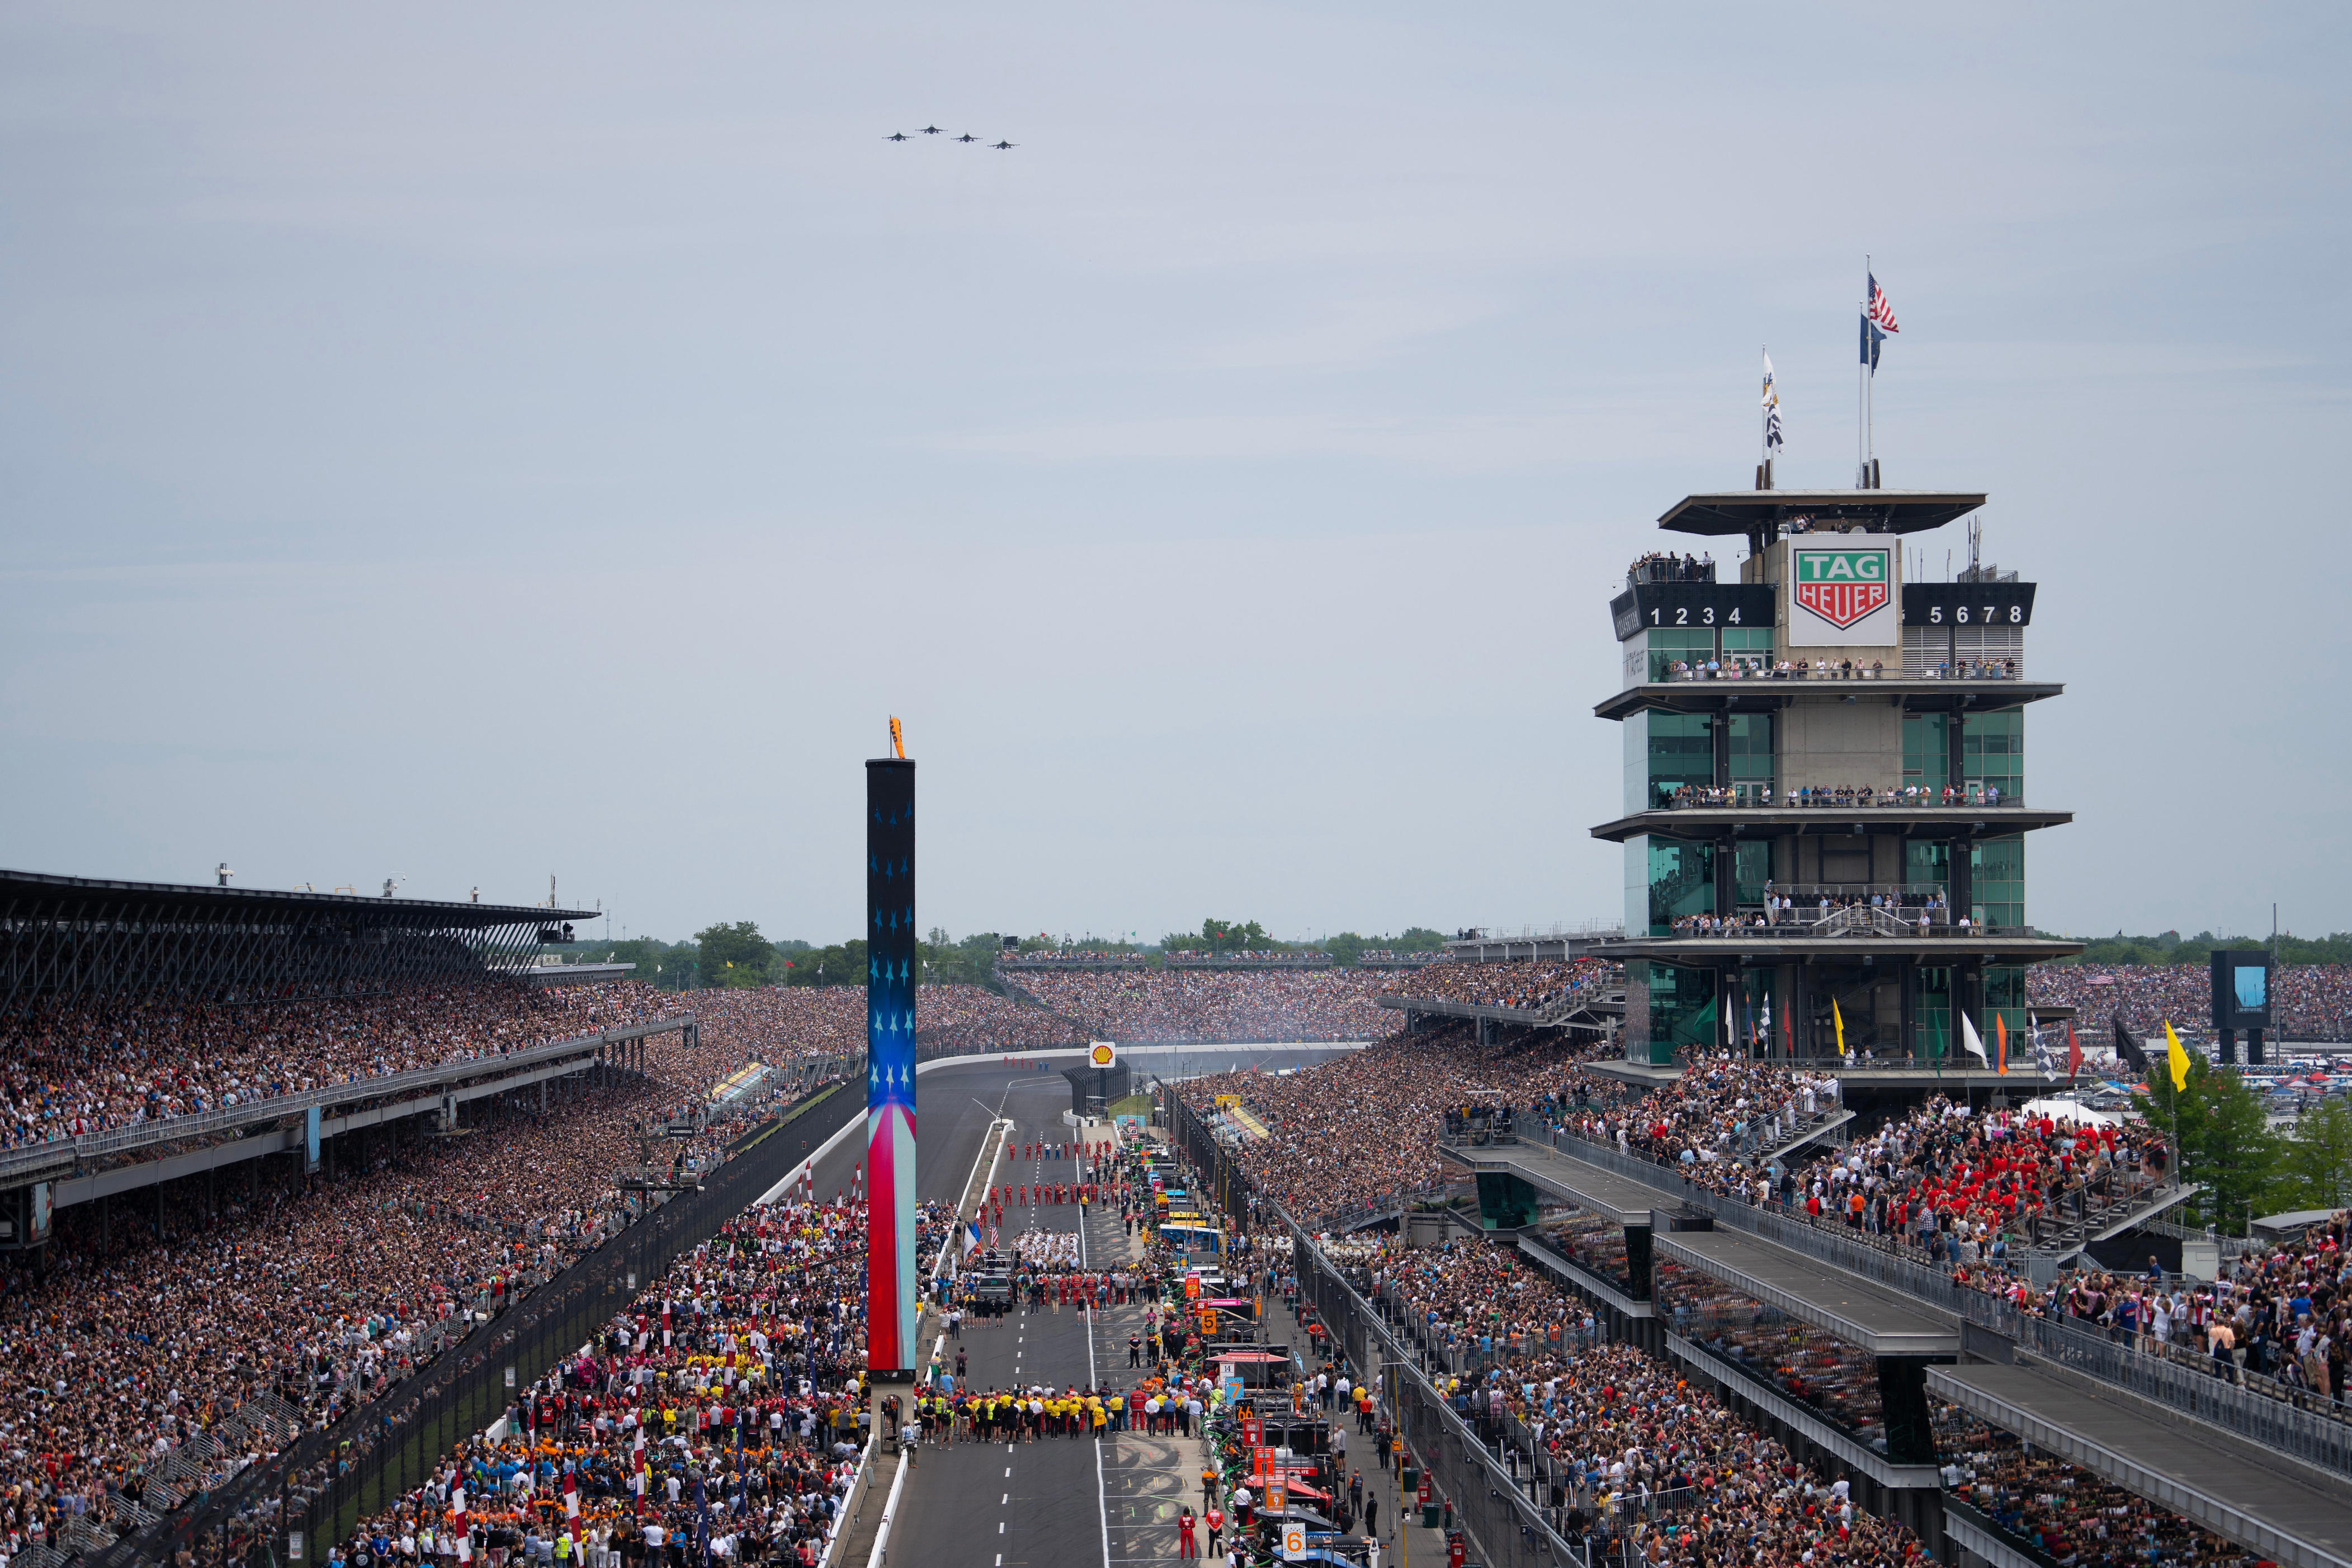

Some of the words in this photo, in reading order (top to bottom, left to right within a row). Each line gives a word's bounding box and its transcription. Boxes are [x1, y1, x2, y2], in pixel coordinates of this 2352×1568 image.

[1804, 555, 1879, 579] TAG
[1802, 585, 1882, 622] HEUER
[1651, 608, 1659, 625] 1
[1676, 608, 1688, 625] 2
[1703, 607, 1715, 625] 3
[1728, 607, 1741, 625] 4
[1930, 607, 1942, 624] 5
[1957, 606, 1968, 624] 6
[1983, 606, 1995, 623] 7
[2010, 606, 2022, 623] 8
[1204, 1316, 1213, 1329] 5
[1230, 1383, 1241, 1399] 7
[1238, 1406, 1253, 1421] 66
[1250, 1433, 1255, 1442] 8
[1274, 1496, 1279, 1506] 9
[1287, 1532, 1302, 1552] 6
